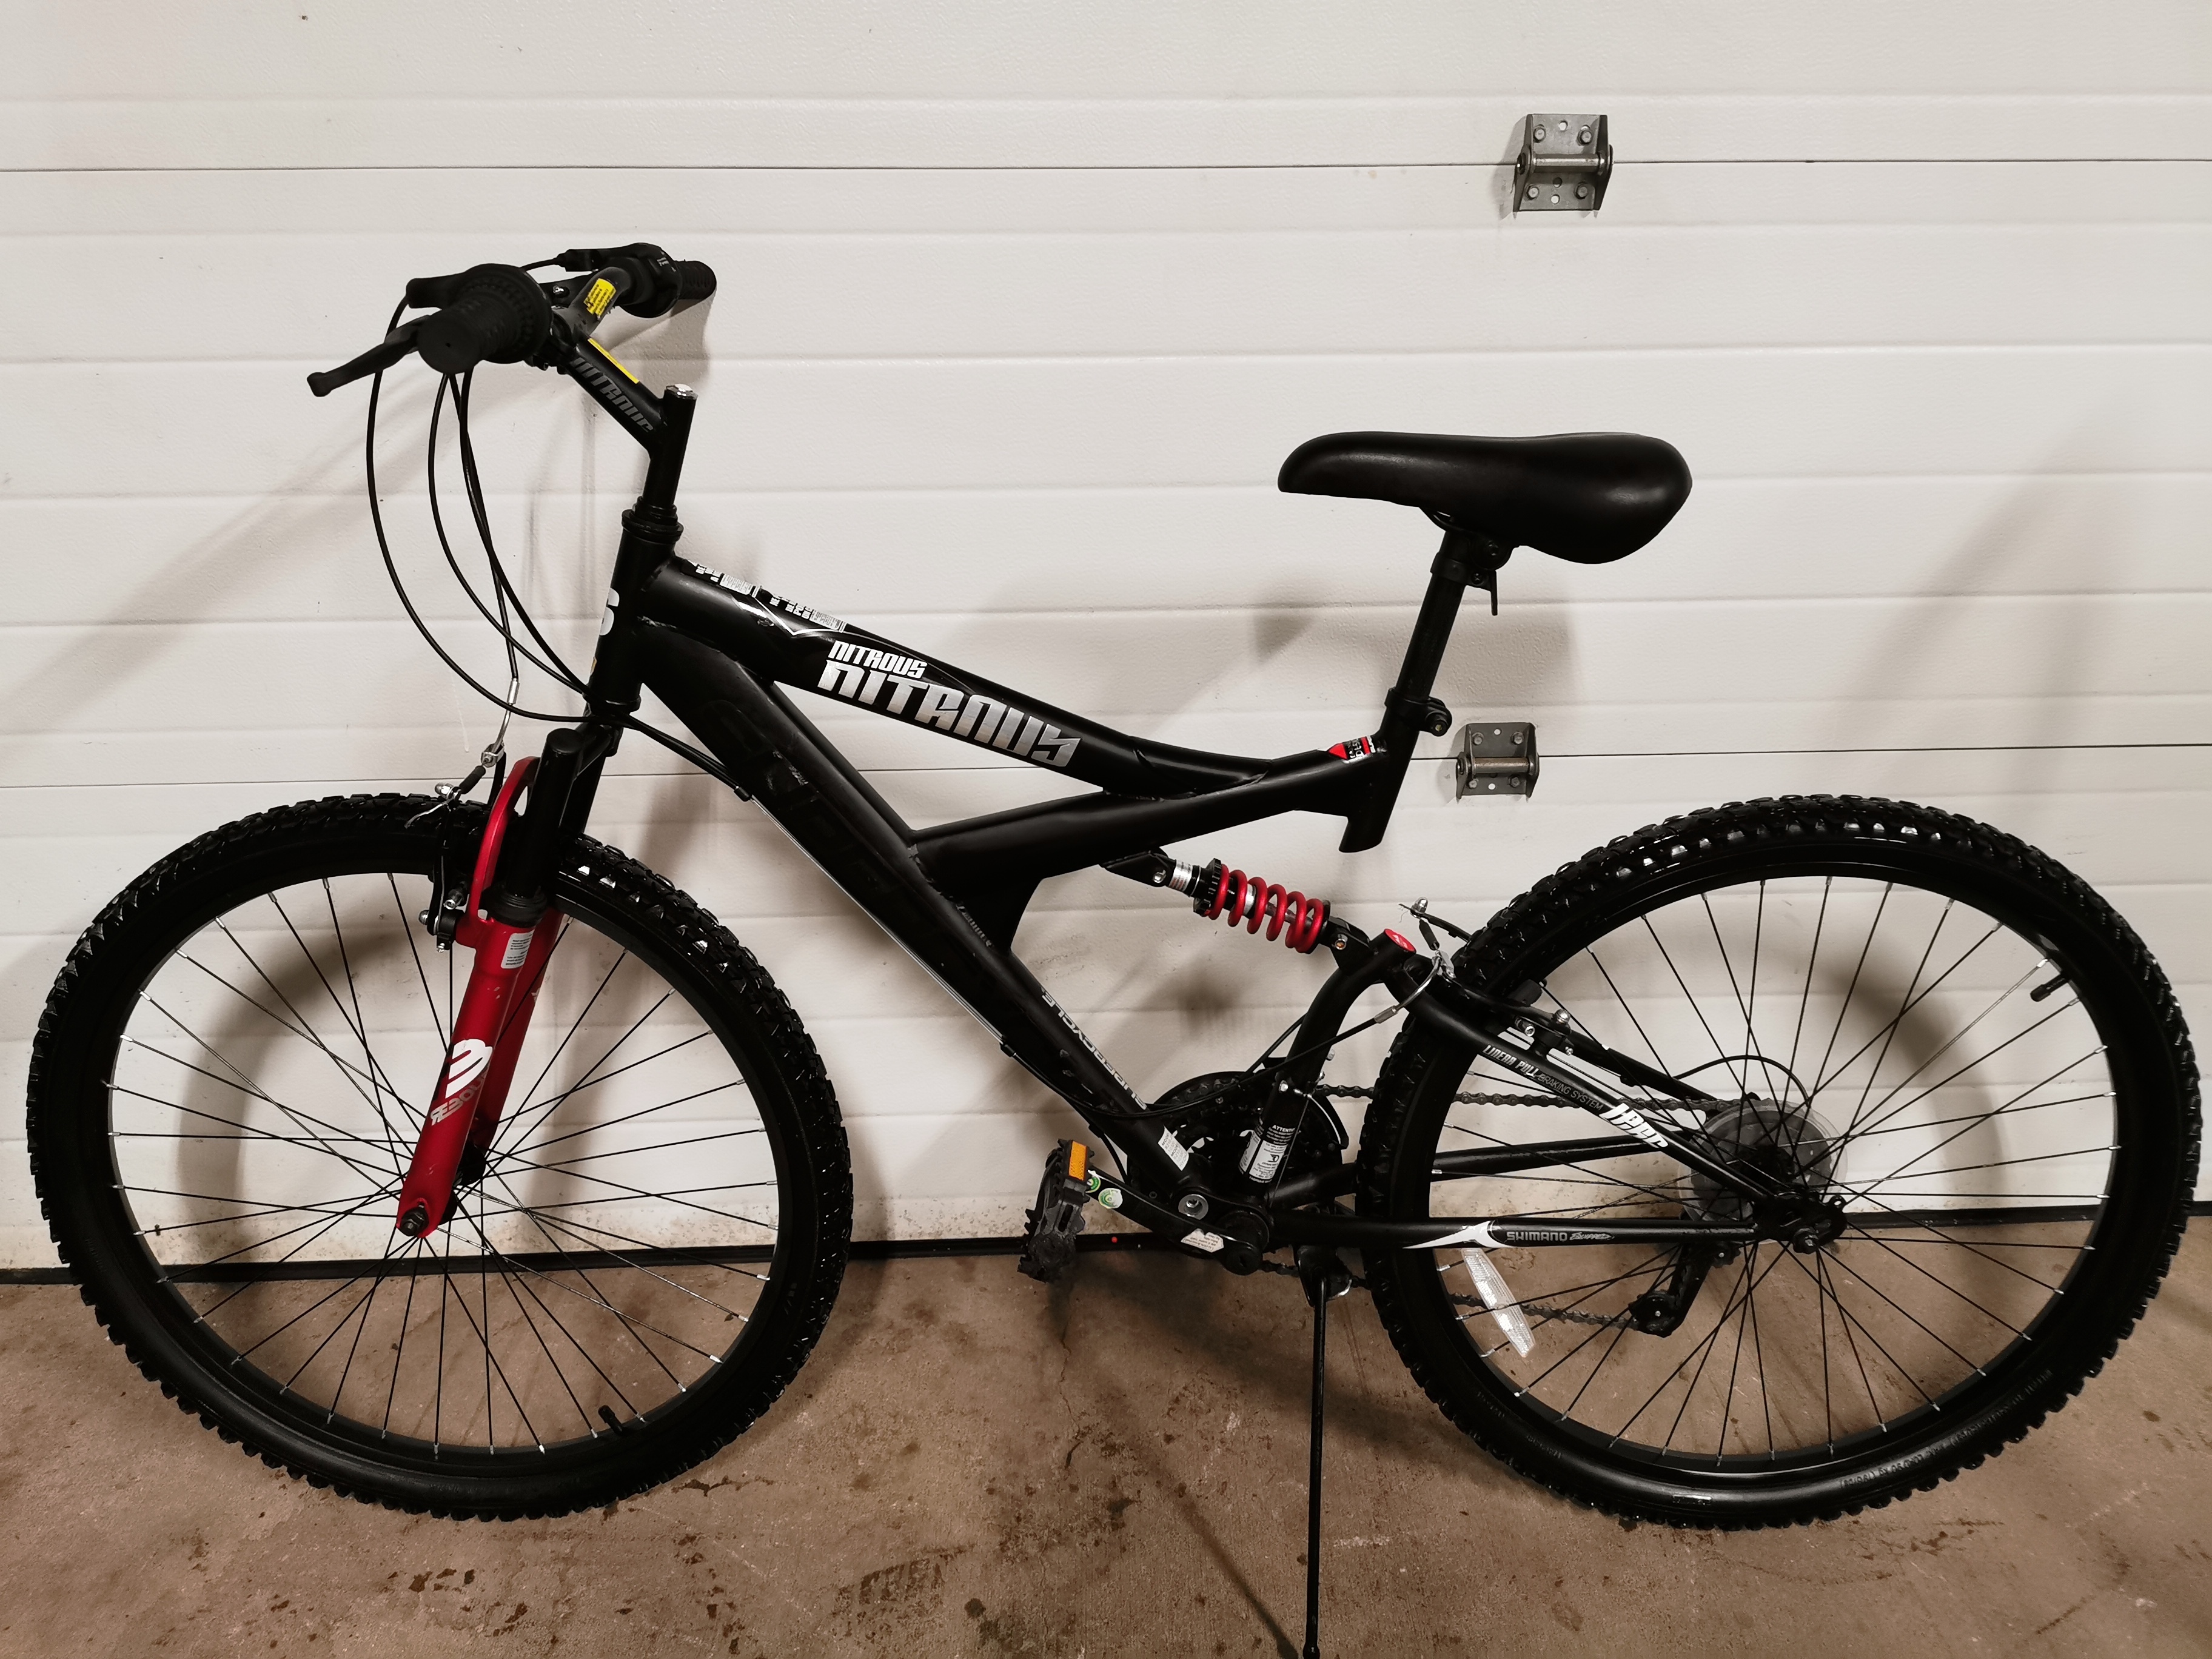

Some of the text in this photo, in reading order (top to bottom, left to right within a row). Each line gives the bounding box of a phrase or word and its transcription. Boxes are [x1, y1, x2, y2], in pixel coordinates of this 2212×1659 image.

[828, 640, 928, 679] NITROUS
[817, 660, 1082, 767] NITROUS
[1482, 1044, 1604, 1111] LINEAR PULL BRAKING SYSTEM
[1506, 1231, 1567, 1241] SHIMANO
